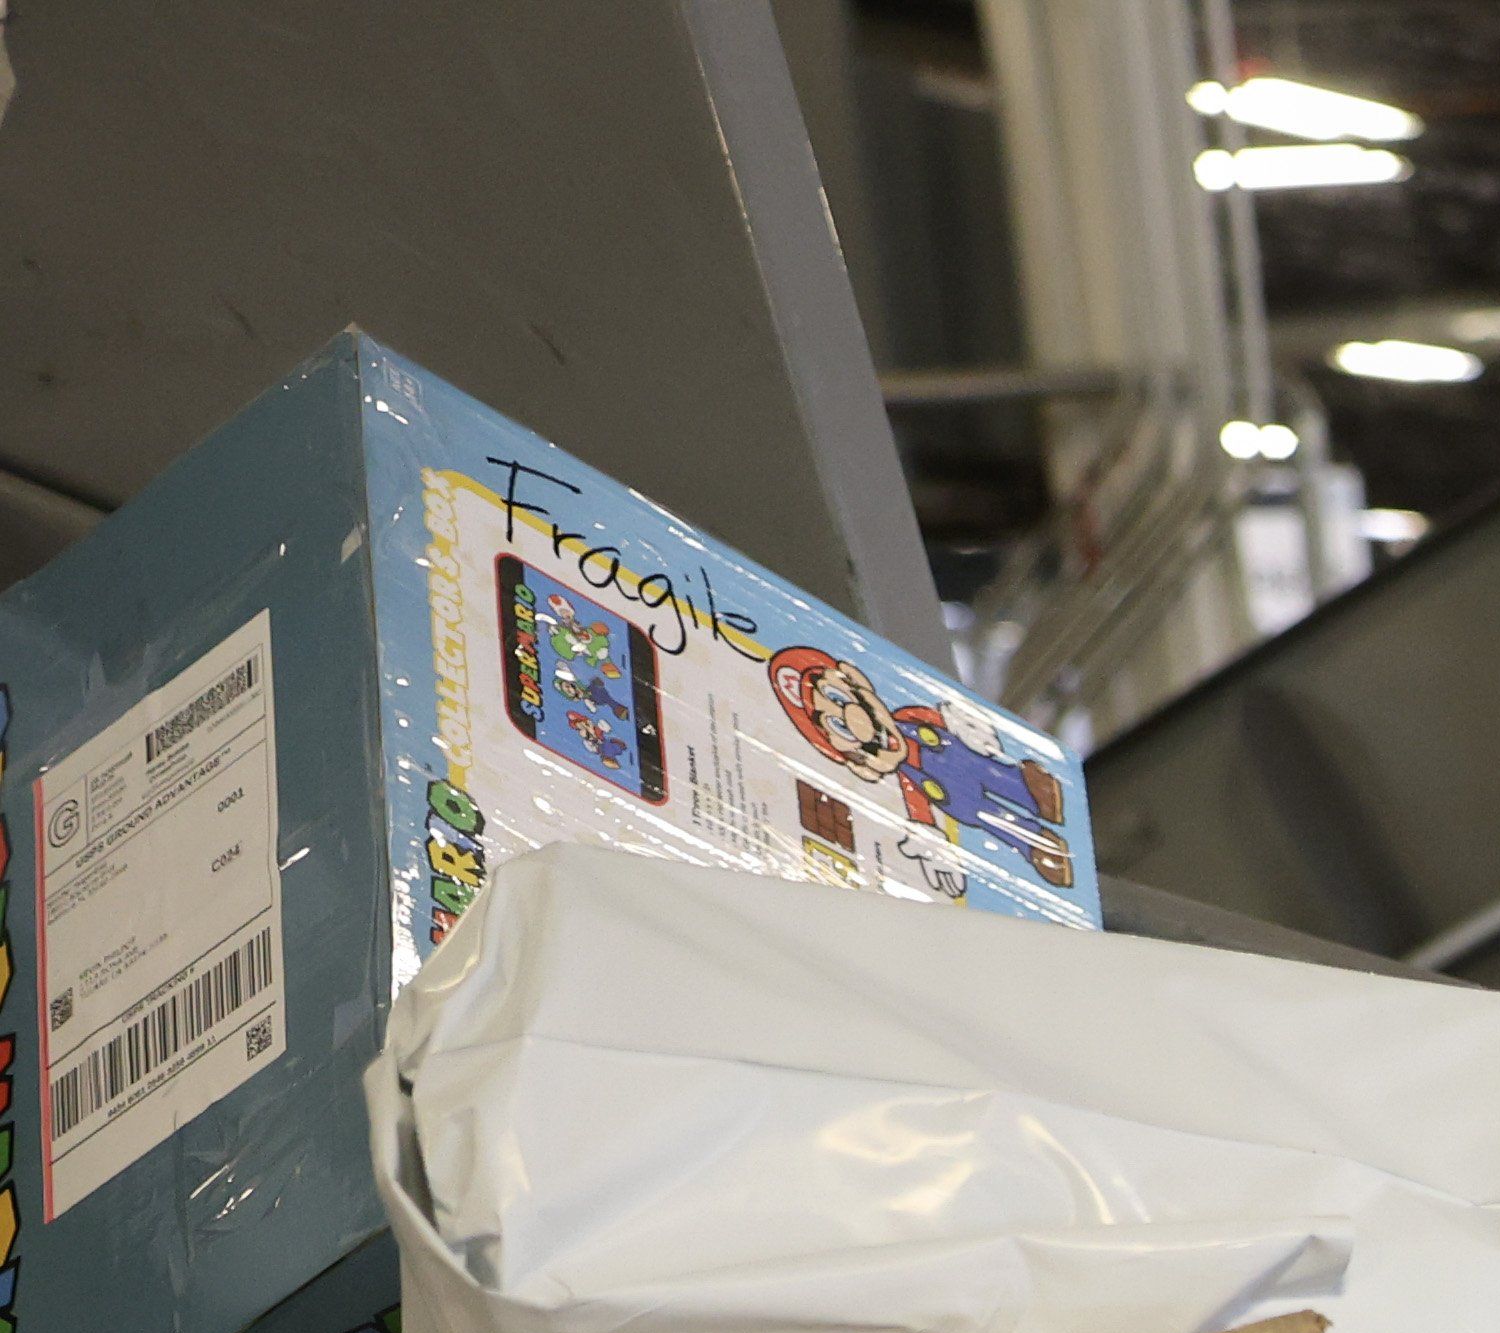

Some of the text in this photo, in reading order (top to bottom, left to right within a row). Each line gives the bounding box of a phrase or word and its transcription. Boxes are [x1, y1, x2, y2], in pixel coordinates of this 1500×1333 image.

[421, 467, 459, 543] BOX
[485, 456, 766, 662] Fragile
[514, 583, 545, 723] SUPER MARIO
[48, 799, 80, 848] G
[106, 806, 152, 846] GROUND
